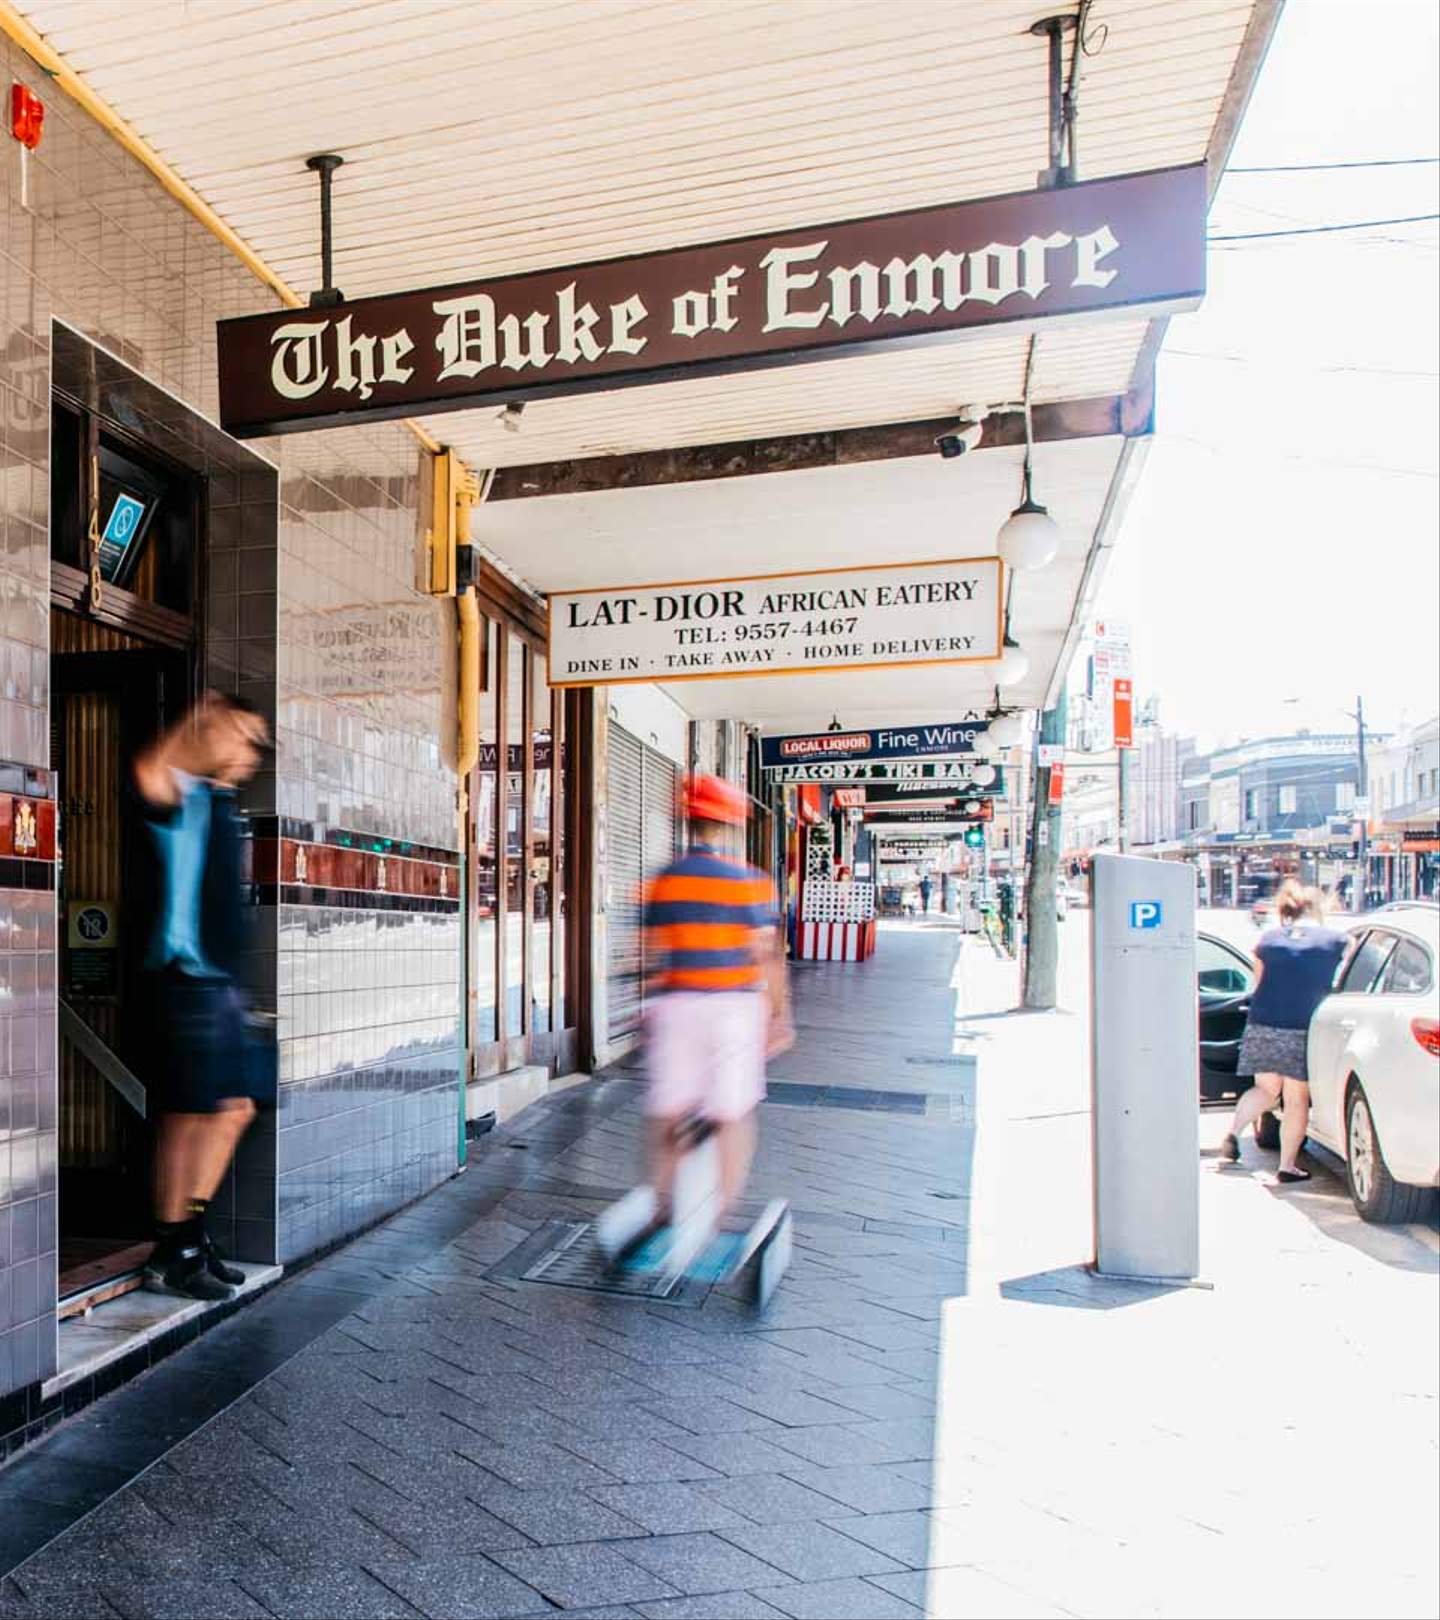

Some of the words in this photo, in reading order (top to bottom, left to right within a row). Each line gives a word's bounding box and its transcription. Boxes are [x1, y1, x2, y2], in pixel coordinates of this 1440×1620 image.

[269, 315, 416, 400] The
[435, 282, 648, 383] Duke
[670, 266, 746, 338] of
[759, 224, 1122, 334] Enmore
[88, 455, 102, 609] 148
[567, 589, 745, 628] LAT-DIOR
[759, 587, 868, 615] AFRICAN
[876, 580, 979, 607] EATERY
[674, 626, 728, 646] TEL:
[734, 617, 859, 642] 9557-4467
[567, 658, 613, 674] DINE
[620, 656, 640, 671] IN
[665, 651, 714, 667] TAKE
[721, 648, 776, 664] AWAY
[803, 642, 864, 659] HOME
[872, 636, 976, 656] DELIVERY
[784, 740, 823, 753] LOCAL
[825, 737, 868, 751] LIQUOR
[878, 731, 919, 749] Fine
[783, 764, 872, 779] JACOBY'S
[887, 763, 923, 778] TIKI
